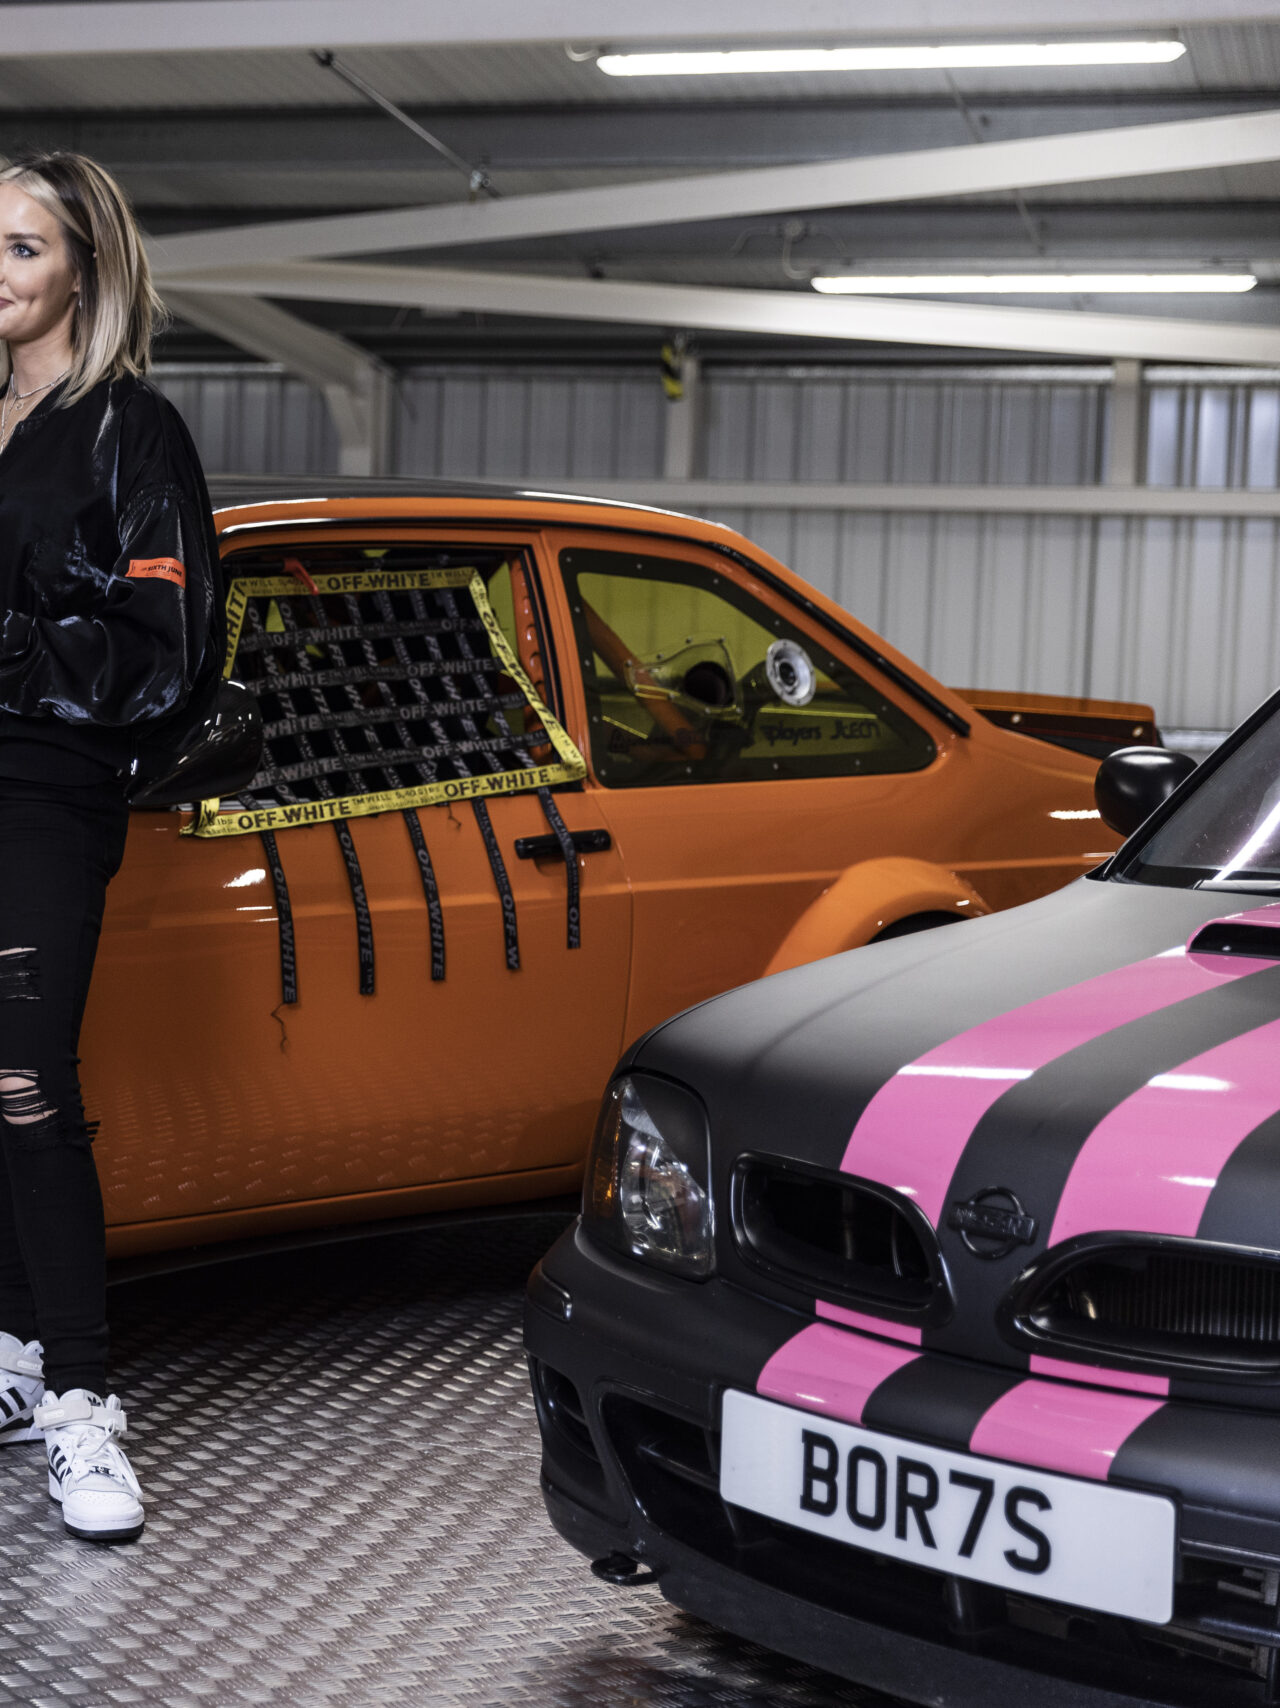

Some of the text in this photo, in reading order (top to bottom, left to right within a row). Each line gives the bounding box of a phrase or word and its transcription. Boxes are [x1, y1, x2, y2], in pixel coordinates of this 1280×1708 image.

[327, 573, 431, 591] OFF-WHITE
[273, 625, 362, 646] OFF-WHITE
[406, 658, 495, 678] OFF-WHITE
[247, 672, 328, 694] FF-WHITE
[400, 698, 488, 720] OFF-WHITE
[263, 714, 323, 740] WHITE
[422, 737, 511, 759] OFF-WHITE
[238, 801, 352, 830] OFF-WHITE
[445, 770, 551, 797] OFF-WHITE
[340, 832, 374, 963] OFF-WHITE
[417, 849, 445, 978] OFF-WHITE
[273, 867, 297, 1002] OFF-WHITE
